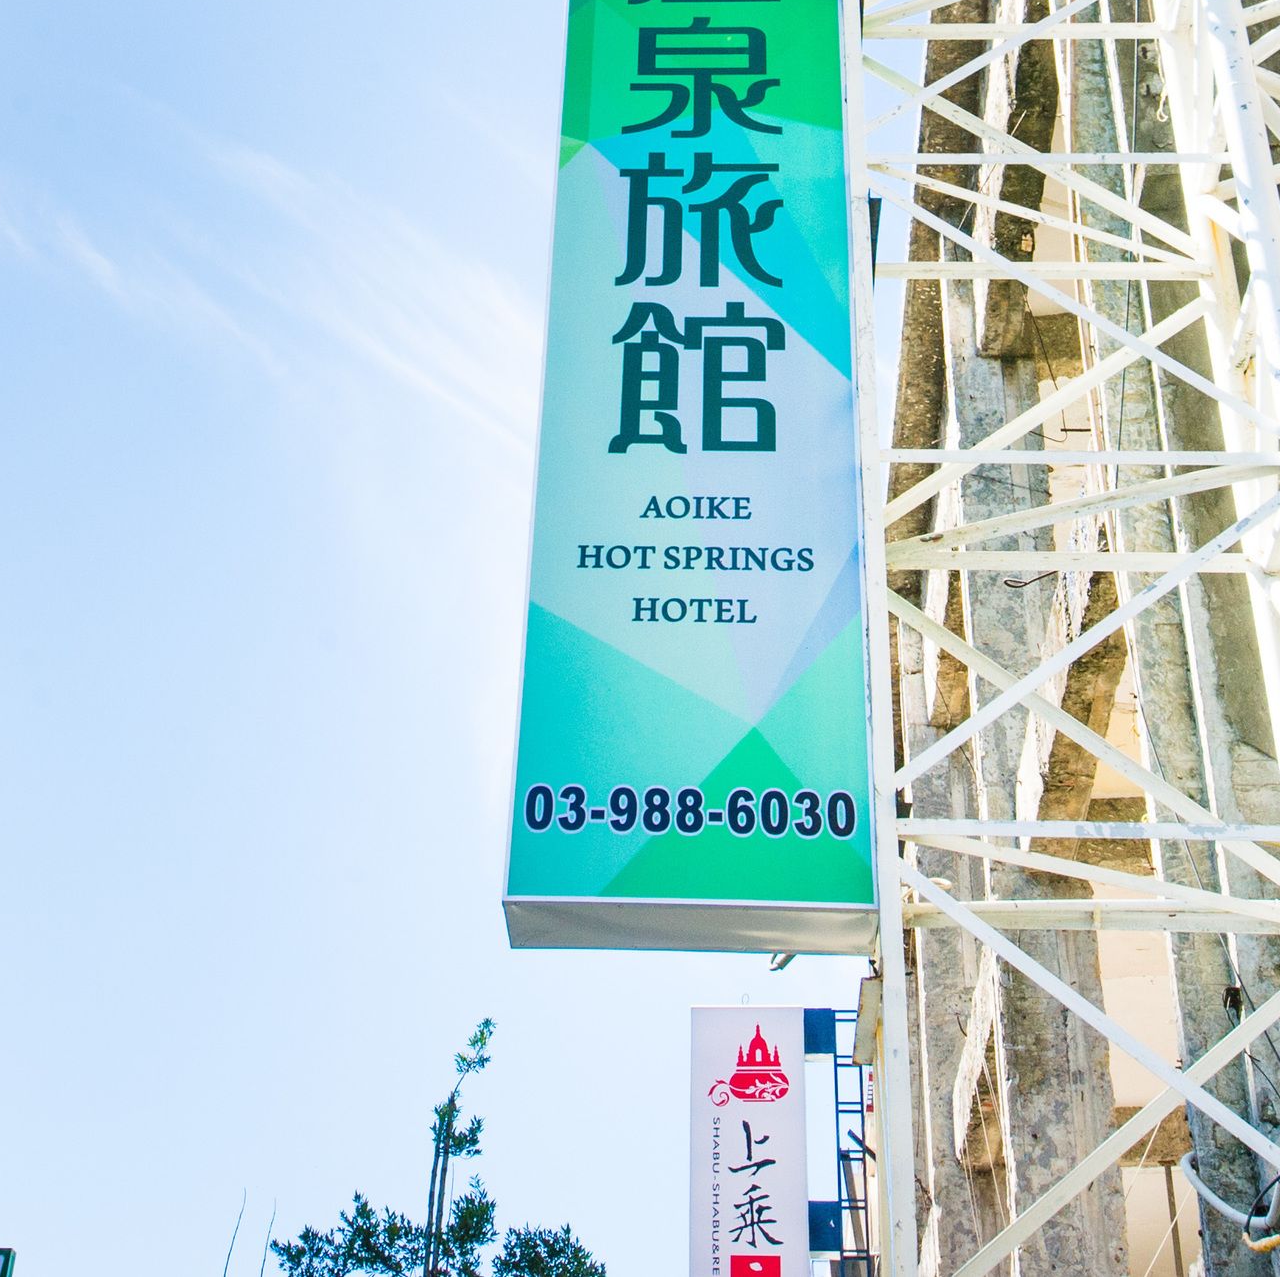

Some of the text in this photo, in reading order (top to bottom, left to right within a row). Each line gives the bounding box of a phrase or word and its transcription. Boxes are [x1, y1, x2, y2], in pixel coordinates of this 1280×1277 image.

[639, 495, 753, 520] AOIKE
[576, 544, 815, 572] HOT SPRINGS
[631, 597, 757, 624] HOTEL
[525, 784, 856, 838] 03-988-6030
[728, 1119, 784, 1249] 上乘
